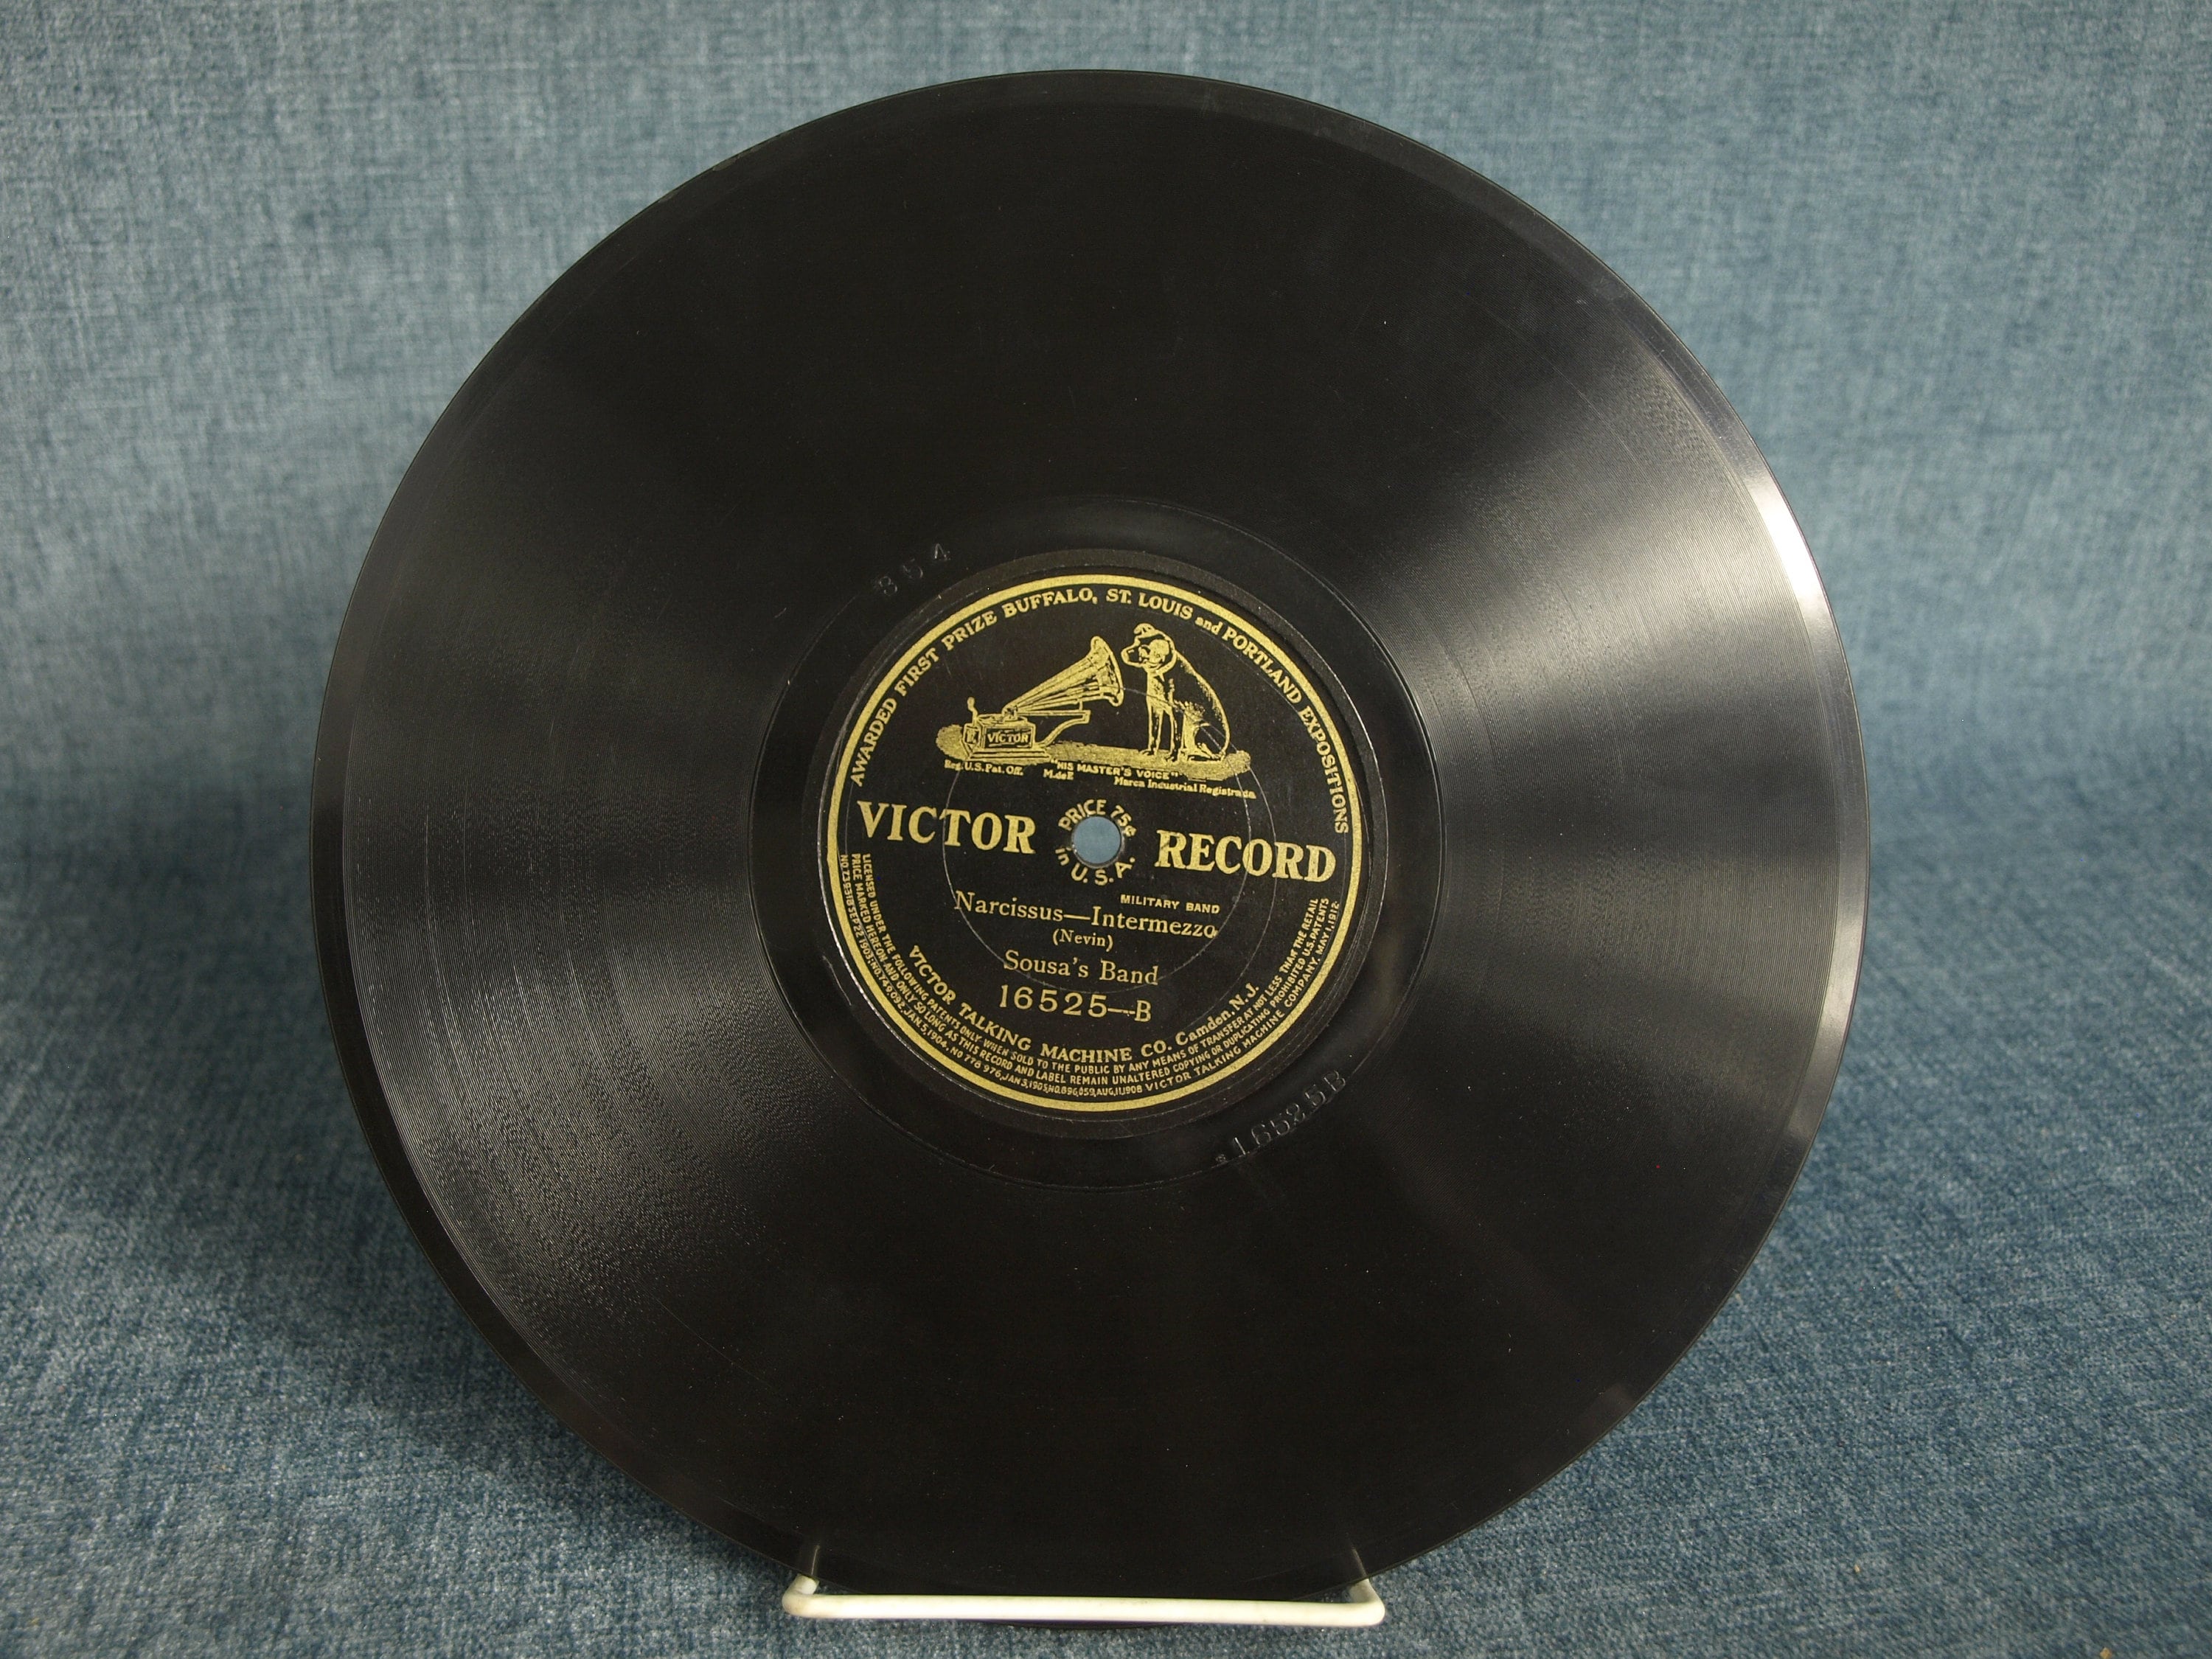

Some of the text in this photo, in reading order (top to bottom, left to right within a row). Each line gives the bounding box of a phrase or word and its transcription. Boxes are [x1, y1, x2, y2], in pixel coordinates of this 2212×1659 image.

[851, 588, 1349, 833] AWARDED FIRST PRIZE BUFFALO, ST. LOUIS and PORTLAND EXPOSITIONS
[987, 731, 1029, 743] VICTOR
[1077, 764, 1132, 776] MASTER'S
[1114, 776, 1256, 799] Marca Industrial Registrada
[1058, 799, 1106, 831] PRICE
[856, 801, 1338, 883] VICTOR RECORD
[1055, 846, 1072, 866] in
[852, 854, 863, 880] PRICE
[855, 883, 871, 922] MARKED
[1120, 894, 1220, 914] MILITARY BAND
[866, 925, 888, 962] HEREON
[1052, 928, 1113, 952] (Nevin)
[863, 854, 1318, 1074] LICENSED UNDER THE FOLLOWING PATENTS ONLY WHEN SOLD TO THE PUBLIC BY ANY MEANS OF TRANSFER AT NOT LESS THAN THE RETAIL
[883, 963, 899, 981] AND
[1004, 950, 1159, 986] Sousa's Band
[897, 981, 918, 1002] ONLY
[1270, 958, 1306, 1006] PROHIBITED
[910, 945, 956, 1005] VICTOR
[959, 1003, 1031, 1051] TALKING
[1040, 1043, 1132, 1066] MACHINE
[1141, 1040, 1172, 1057] CO.
[914, 1001, 926, 1014] SO
[1145, 1072, 1192, 1091] VICTOR
[1194, 1046, 1241, 1076] TALKING
[1242, 1010, 1284, 1047] MACHINE
[1315, 932, 1329, 955] MAY
[924, 1010, 946, 1032] LONG
[1222, 1009, 1270, 1048] DUPLICATING
[945, 1030, 959, 1041] AS
[959, 1037, 979, 1054] THIS
[979, 1050, 1012, 1070] RECORD
[1211, 1045, 1222, 1055] OR
[1015, 1065, 1034, 1077] AND
[1173, 1051, 1211, 1072] COPYING
[1036, 1070, 1066, 1083] LABEL
[1070, 1075, 1107, 1085] REMAIN
[1113, 1067, 1170, 1085] UNALTERED
